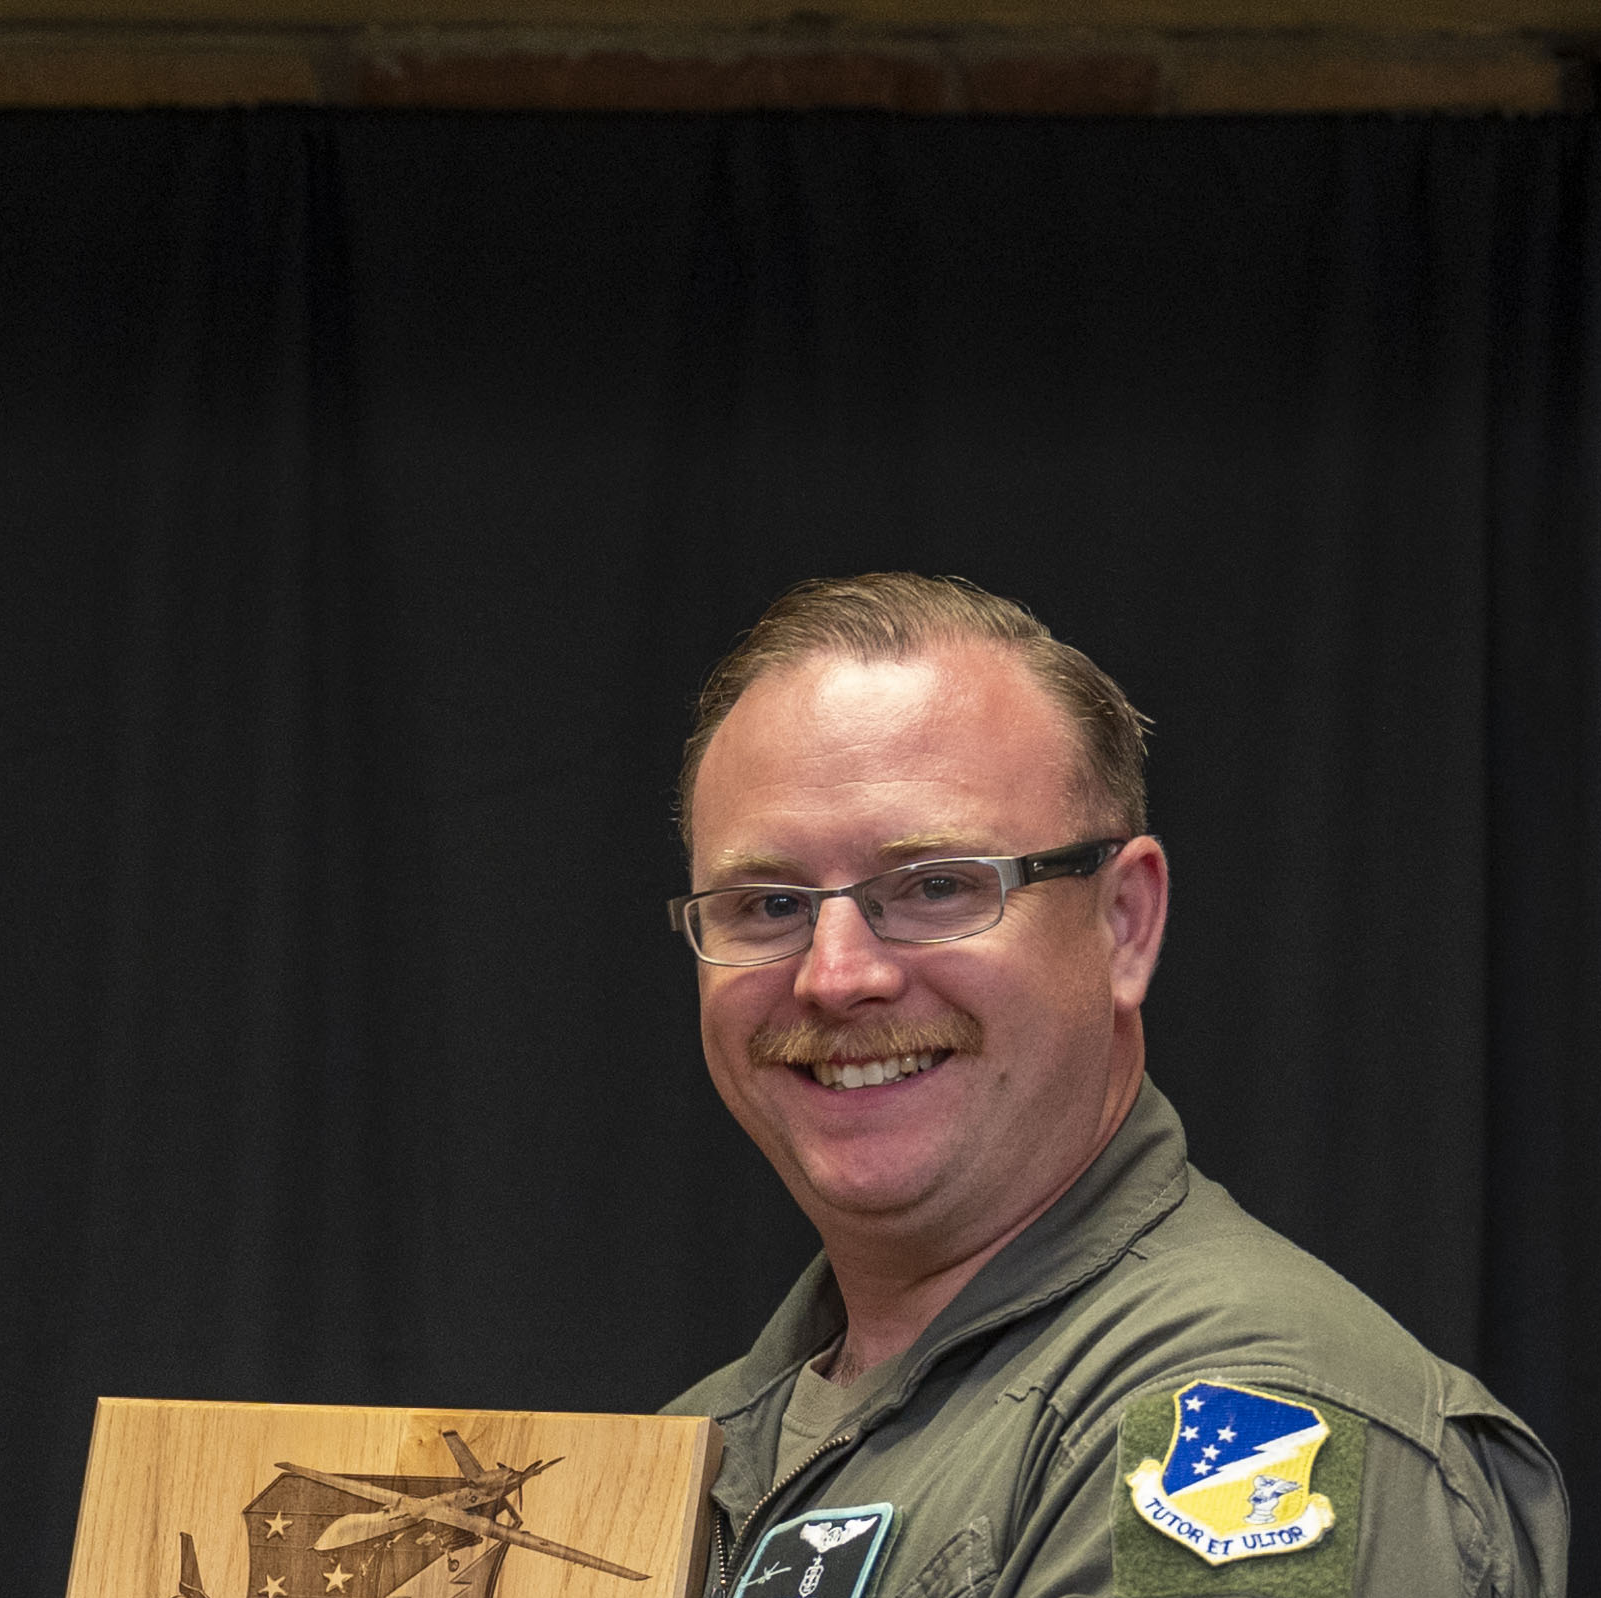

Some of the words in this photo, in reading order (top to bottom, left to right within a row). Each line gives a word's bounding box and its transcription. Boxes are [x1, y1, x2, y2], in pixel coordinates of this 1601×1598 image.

[1145, 1497, 1205, 1544] TUTOR
[1207, 1538, 1234, 1555] ET
[1243, 1526, 1305, 1550] ULTOR
